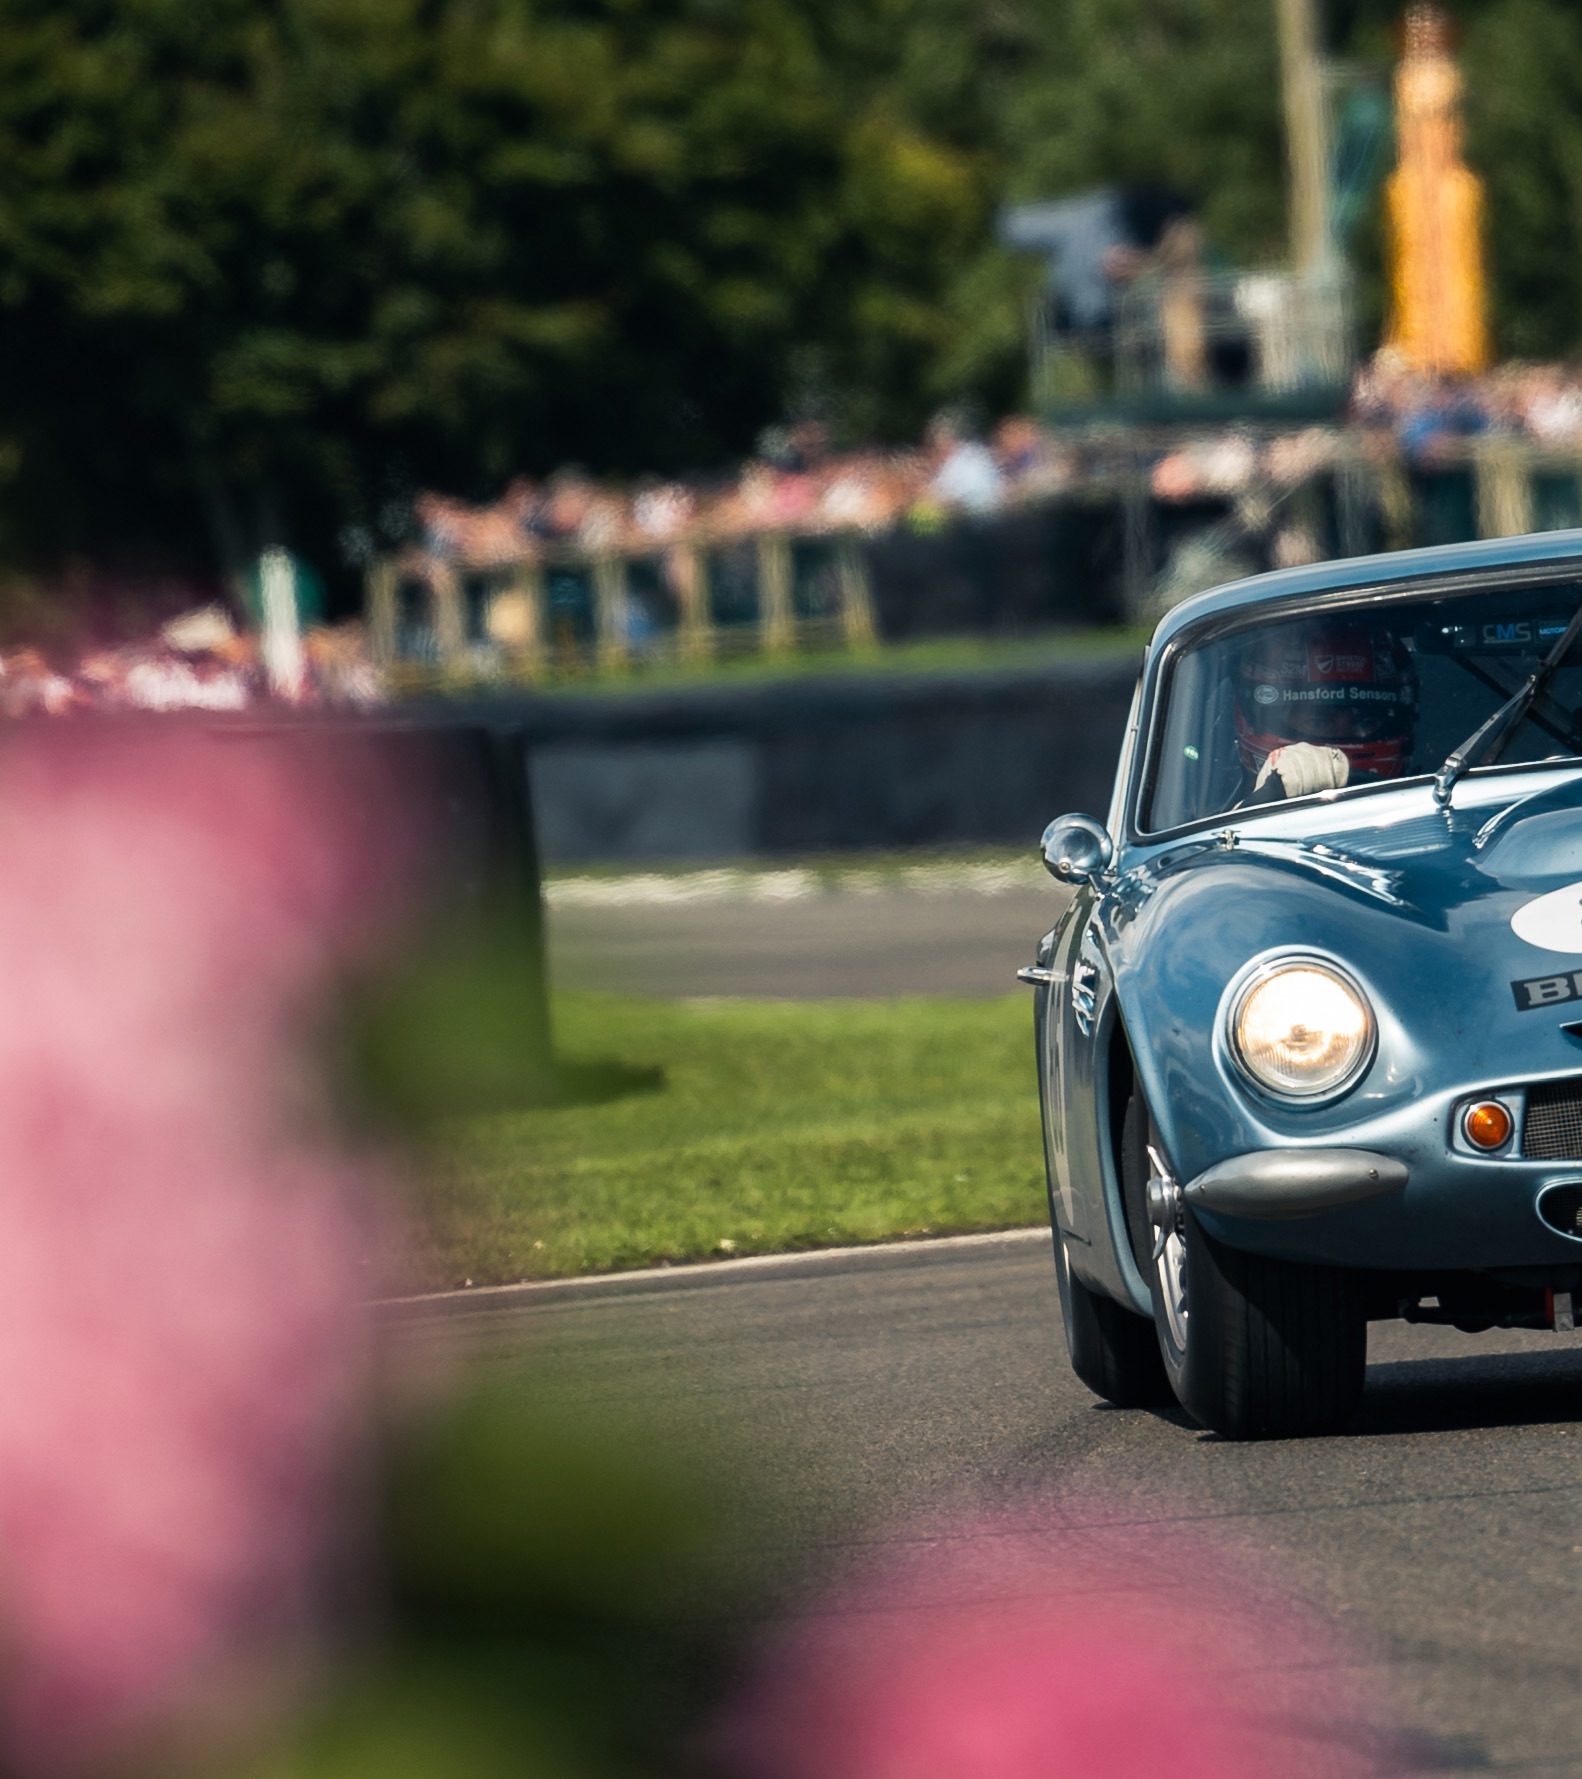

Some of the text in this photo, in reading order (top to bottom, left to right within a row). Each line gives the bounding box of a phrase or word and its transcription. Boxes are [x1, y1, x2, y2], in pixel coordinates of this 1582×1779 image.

[1482, 621, 1532, 643] CMS
[1283, 687, 1397, 702] Hansford Sensors
